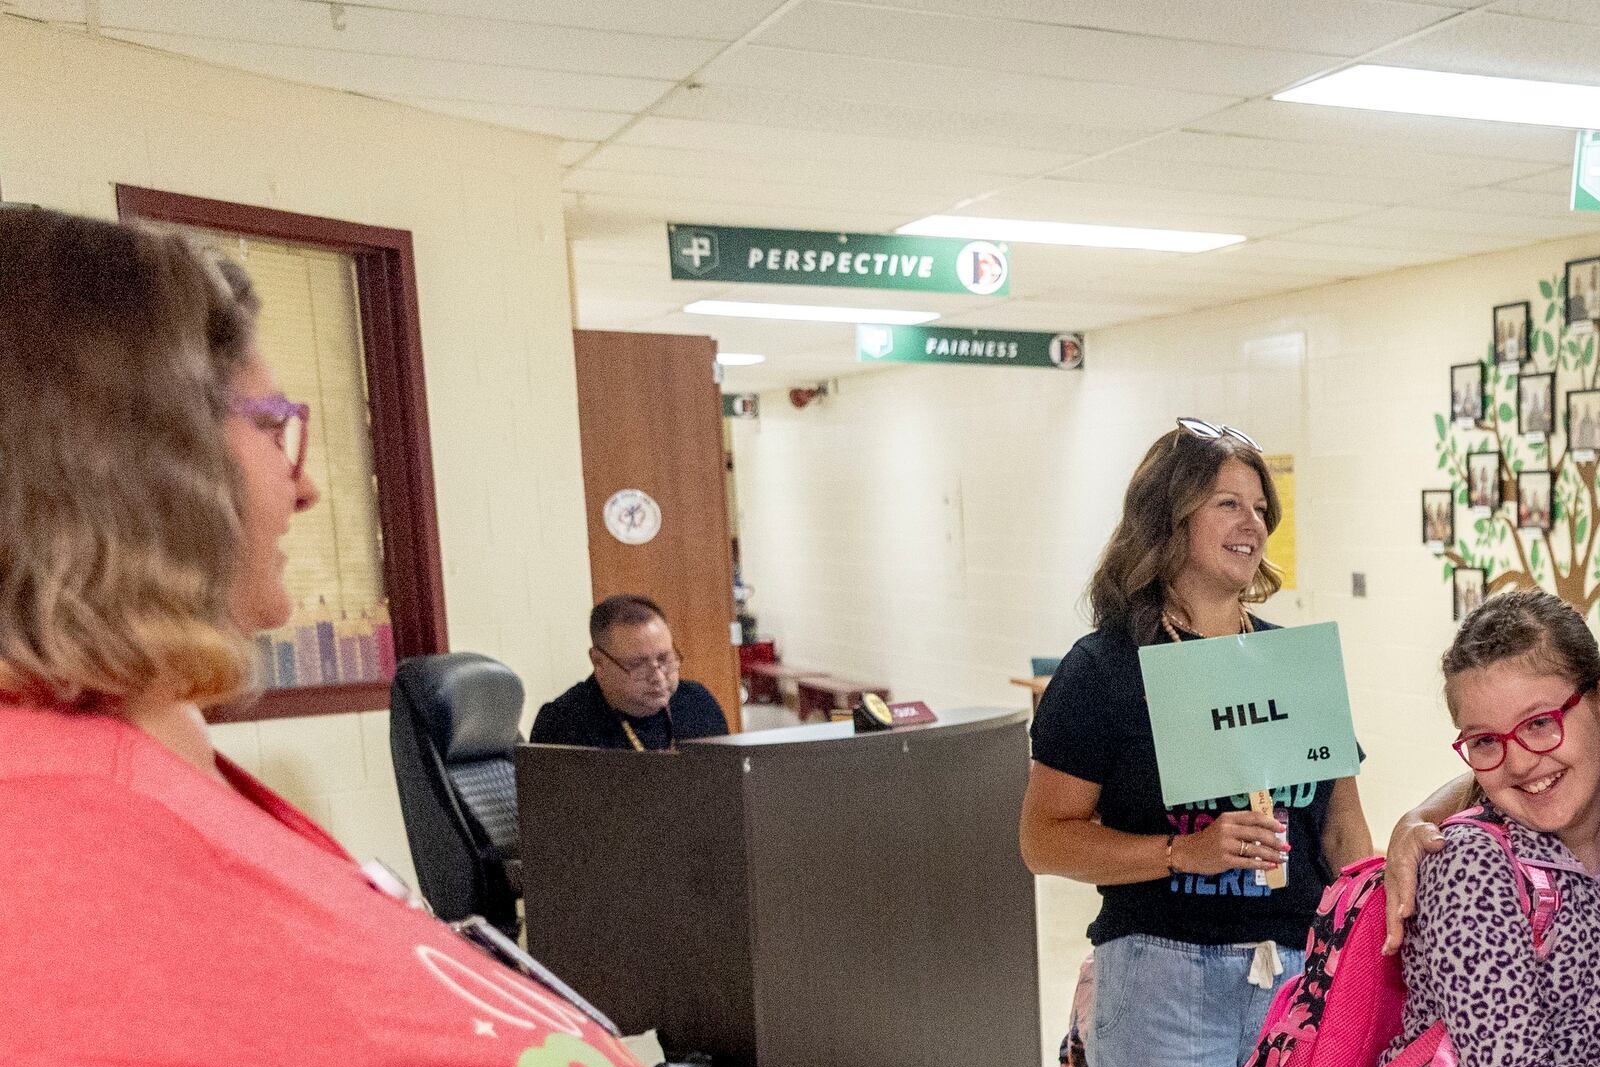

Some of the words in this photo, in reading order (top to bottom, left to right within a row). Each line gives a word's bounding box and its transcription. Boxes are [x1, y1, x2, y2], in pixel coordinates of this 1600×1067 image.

[748, 248, 934, 278] PERSPECTIVE
[925, 337, 1018, 359] FAIRNESS
[1211, 699, 1288, 731] HILL
[1307, 746, 1330, 761] 48
